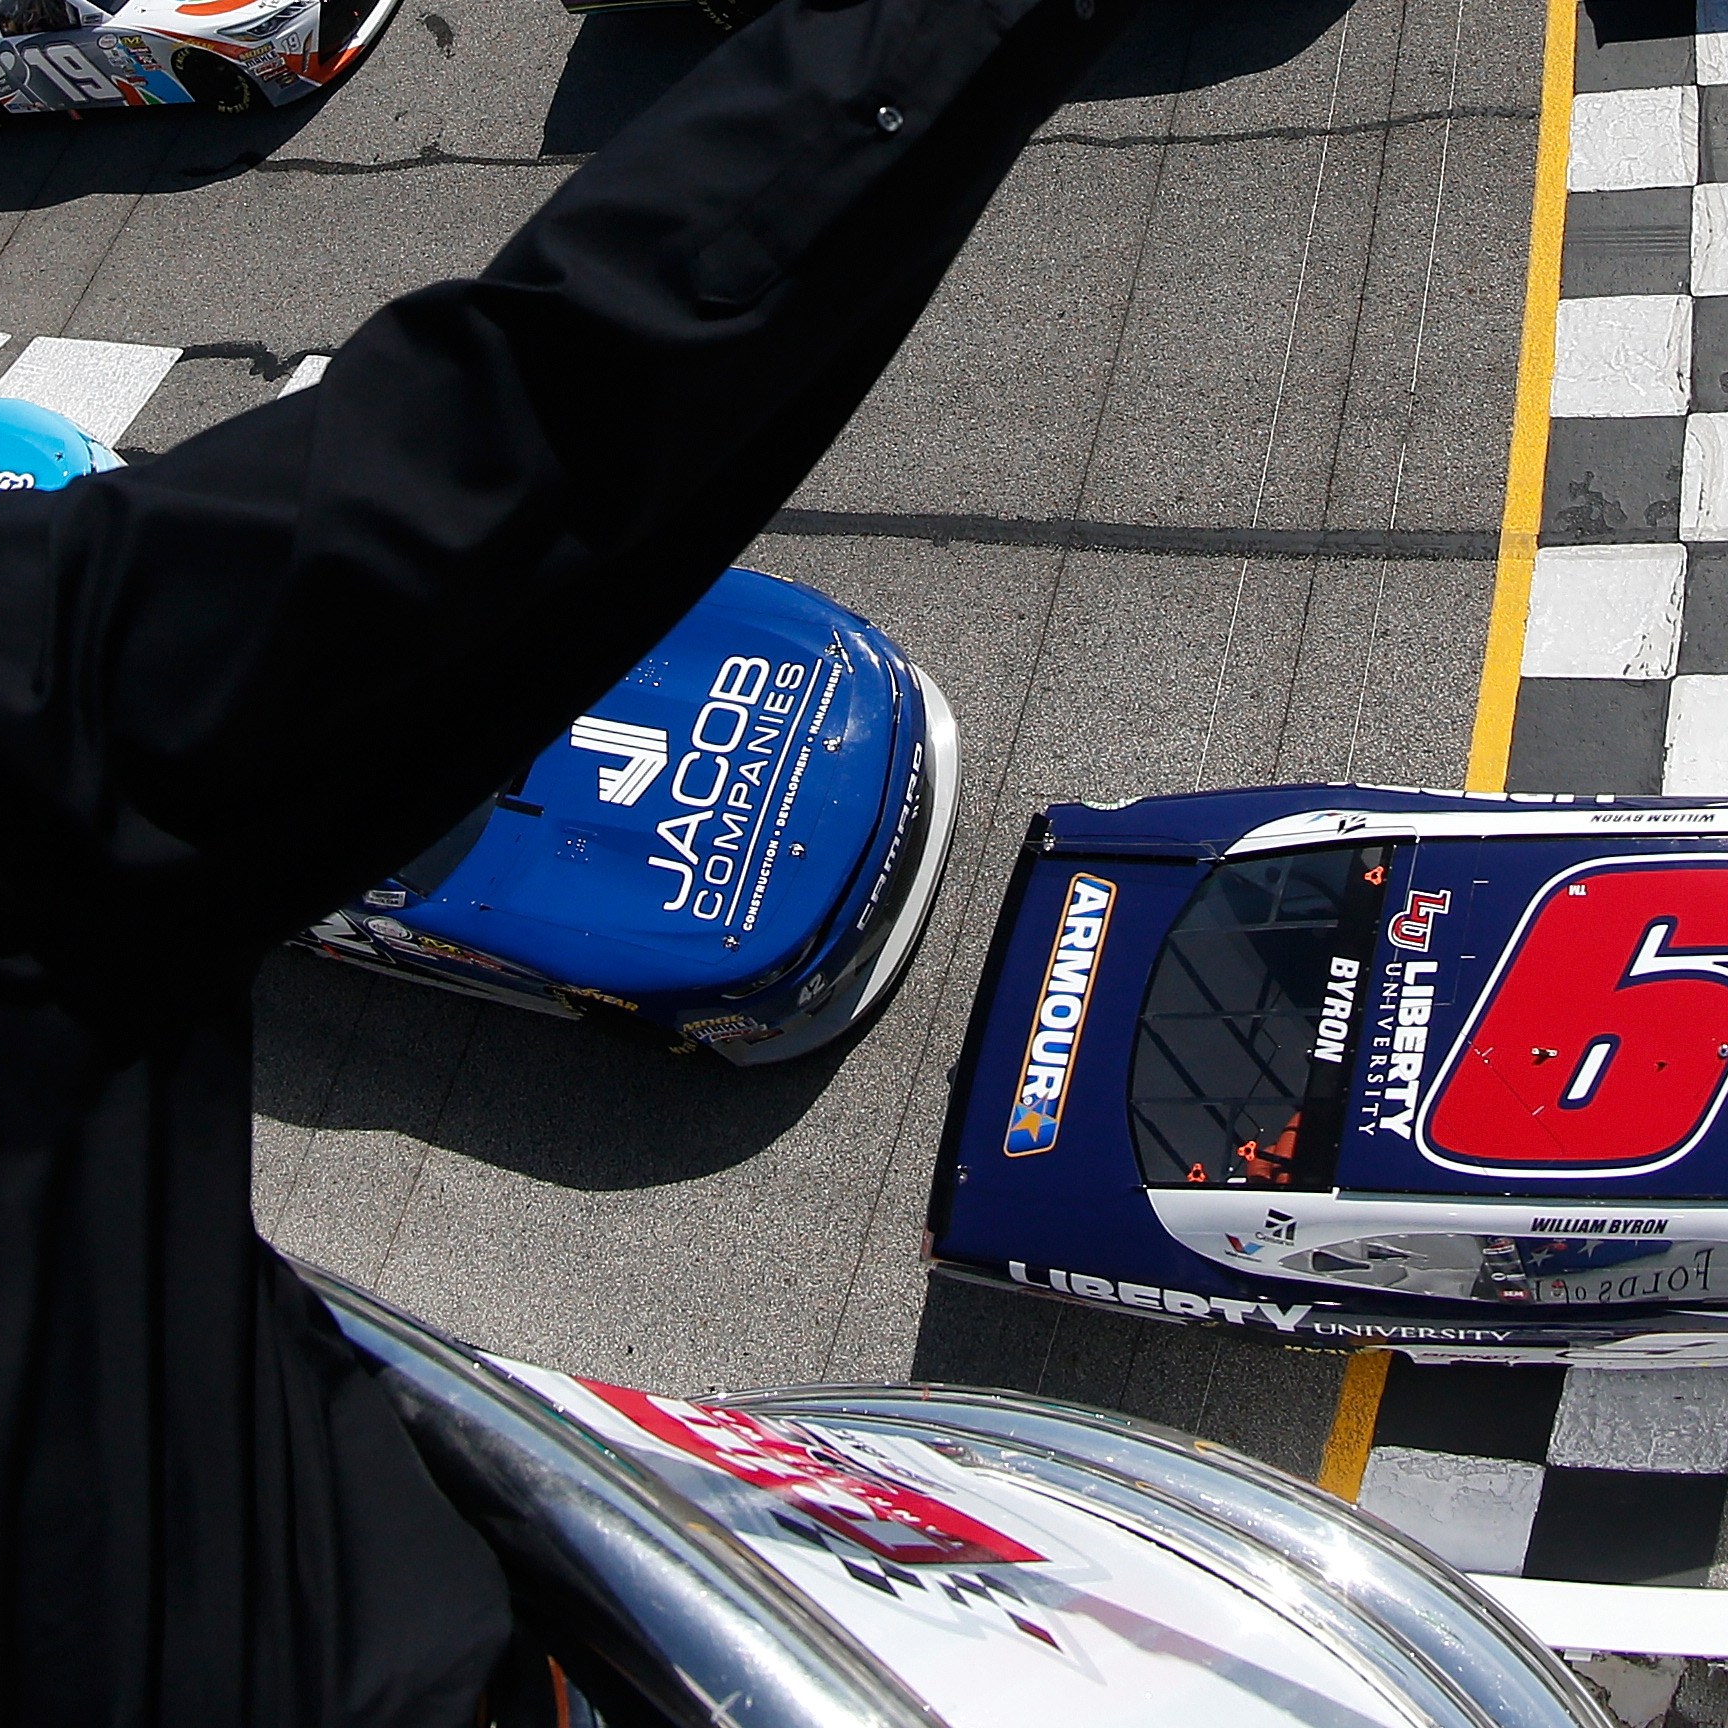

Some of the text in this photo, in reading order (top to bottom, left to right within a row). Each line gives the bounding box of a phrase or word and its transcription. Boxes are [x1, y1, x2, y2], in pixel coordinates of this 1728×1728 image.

[23, 41, 124, 103] 19
[648, 654, 771, 912] JACOB
[692, 661, 806, 921] COMPANIES
[741, 661, 845, 932] CONSTRUCTION DEVELOPMENT MANAGEMENT
[856, 741, 924, 931] CAMARO
[1590, 812, 1715, 824] WILLIAM BYRON
[1569, 884, 1587, 898] TM
[796, 973, 827, 1009] 42
[1021, 880, 1110, 1103] ARMOUR
[1313, 955, 1360, 1063] BYRON
[1358, 962, 1403, 1137] UNIVERSITY
[1379, 960, 1438, 1141] LIBERTY
[1530, 1217, 1669, 1235] WILLIAM BYRON
[1009, 1260, 1313, 1332] LIBERTY
[1313, 1322, 1512, 1343] UNIVERSITY
